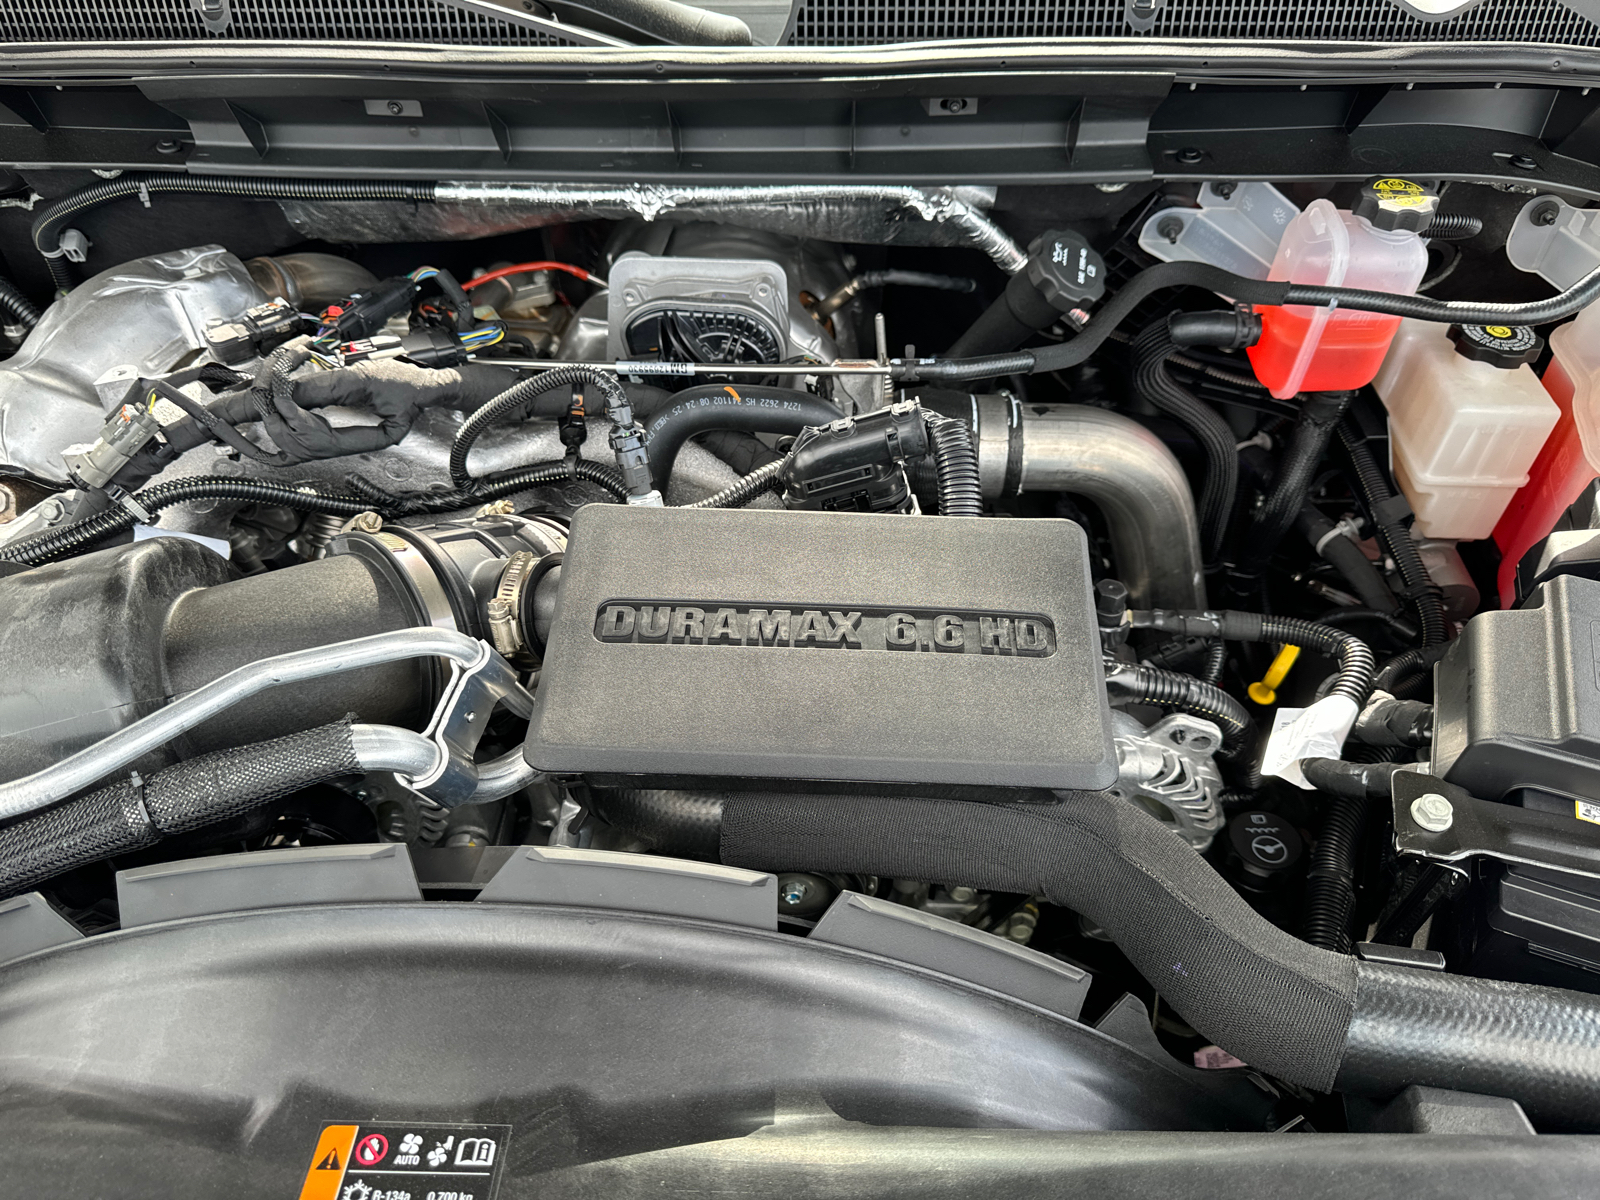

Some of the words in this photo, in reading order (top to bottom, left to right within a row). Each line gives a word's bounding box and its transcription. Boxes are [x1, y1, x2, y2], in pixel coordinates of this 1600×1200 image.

[745, 398, 756, 407] HS
[760, 399, 779, 408] 2622
[783, 401, 802, 412] 1274
[602, 605, 862, 645] DURAMAX
[884, 611, 966, 653] 6.6
[979, 615, 1048, 655] HD
[394, 1155, 420, 1165] AUTO
[371, 1189, 411, 1200] R-134a
[426, 1191, 458, 1200] 0700
